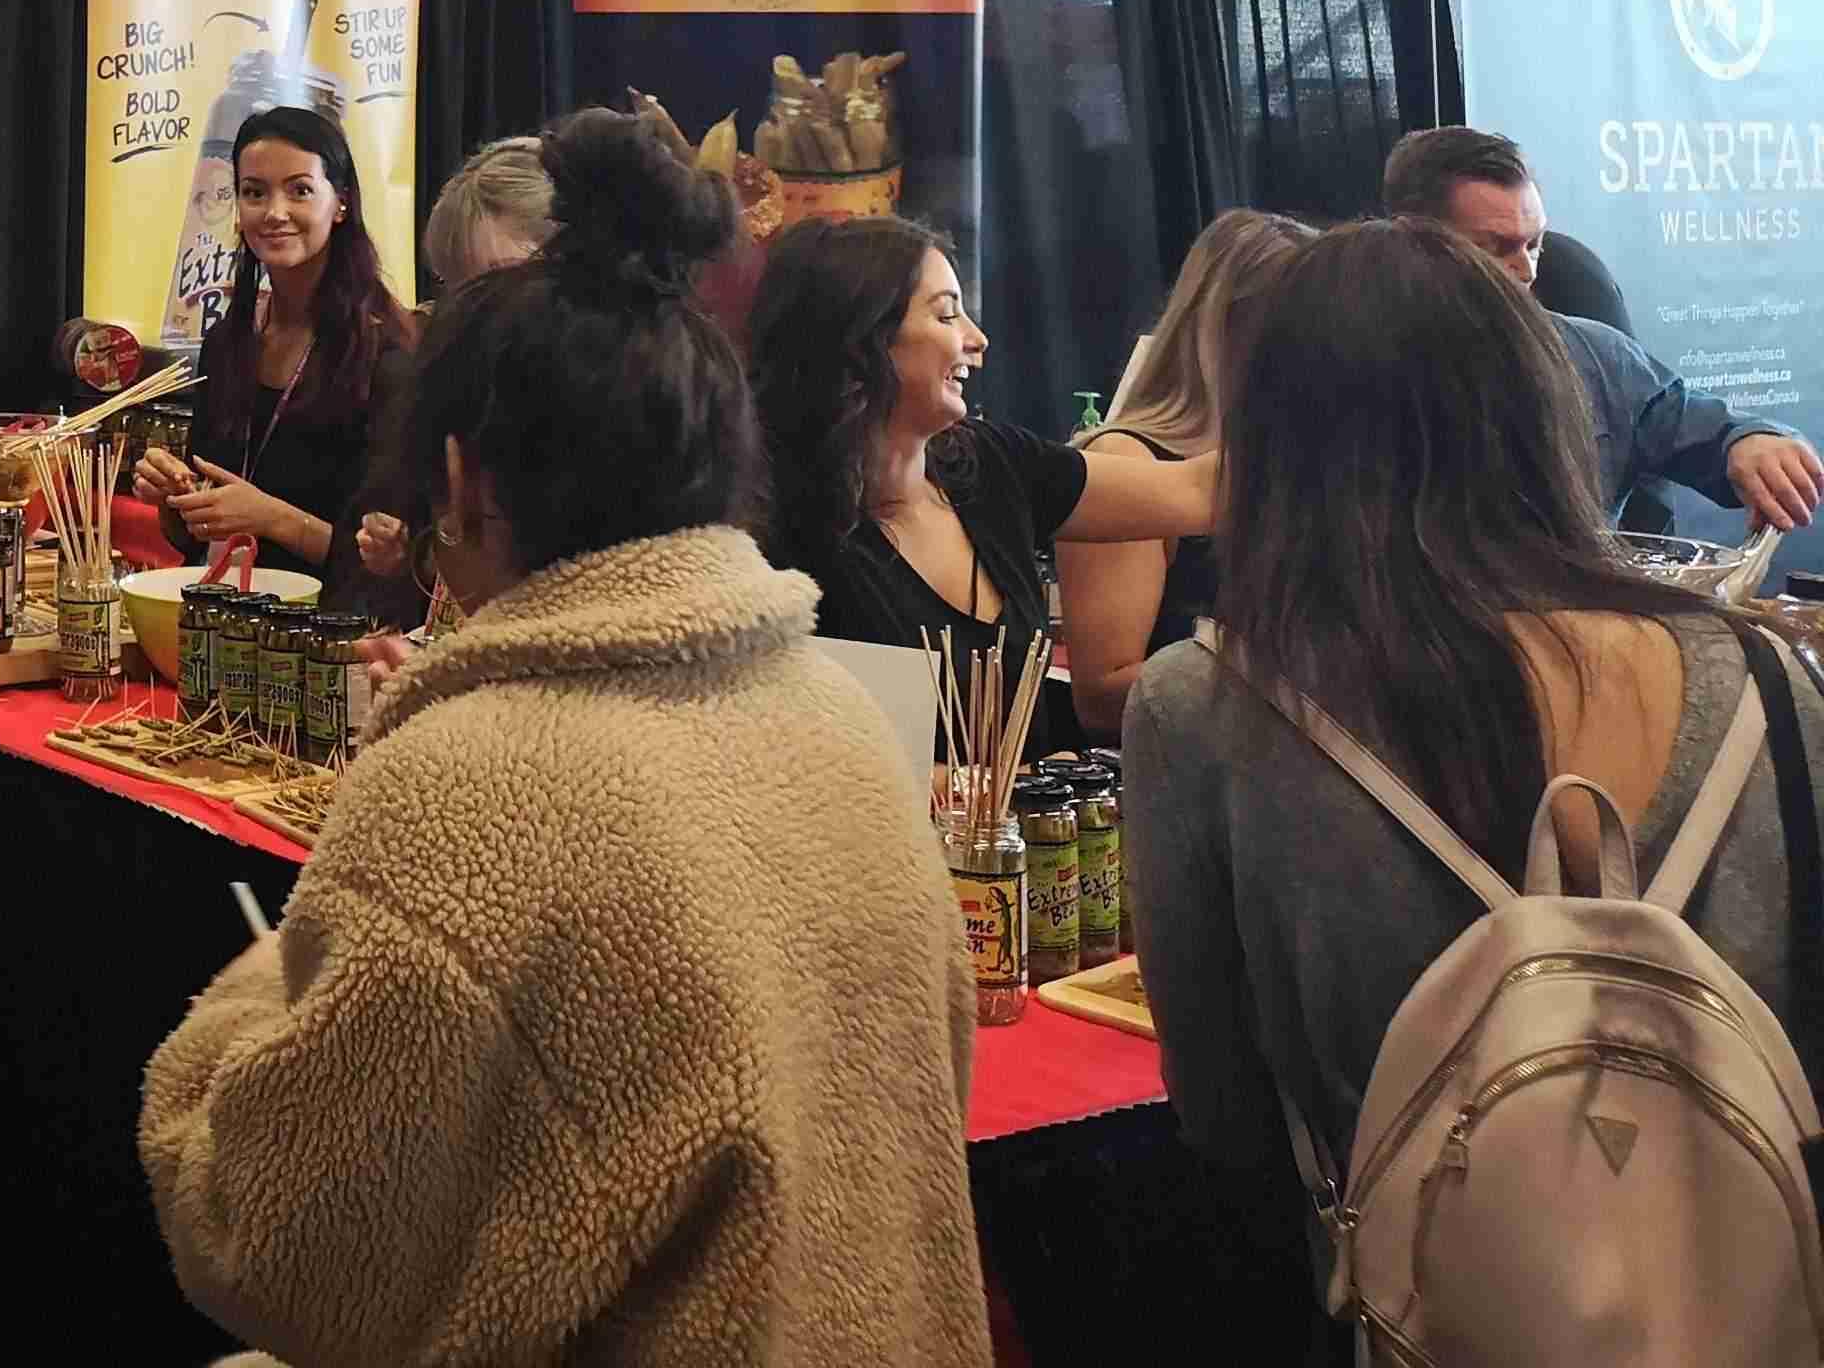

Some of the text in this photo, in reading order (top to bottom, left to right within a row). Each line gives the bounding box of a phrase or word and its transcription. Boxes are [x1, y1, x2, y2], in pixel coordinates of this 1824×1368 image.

[333, 5, 407, 35] STIR UP
[124, 21, 164, 50] BIG
[351, 32, 406, 60] SOME
[97, 43, 195, 80] CRUNCH!
[367, 59, 401, 87] FUN
[126, 89, 180, 118] BOLD
[112, 116, 191, 146] FLAVOR
[1658, 208, 1801, 246] WELLNESS
[179, 243, 241, 298] Extr
